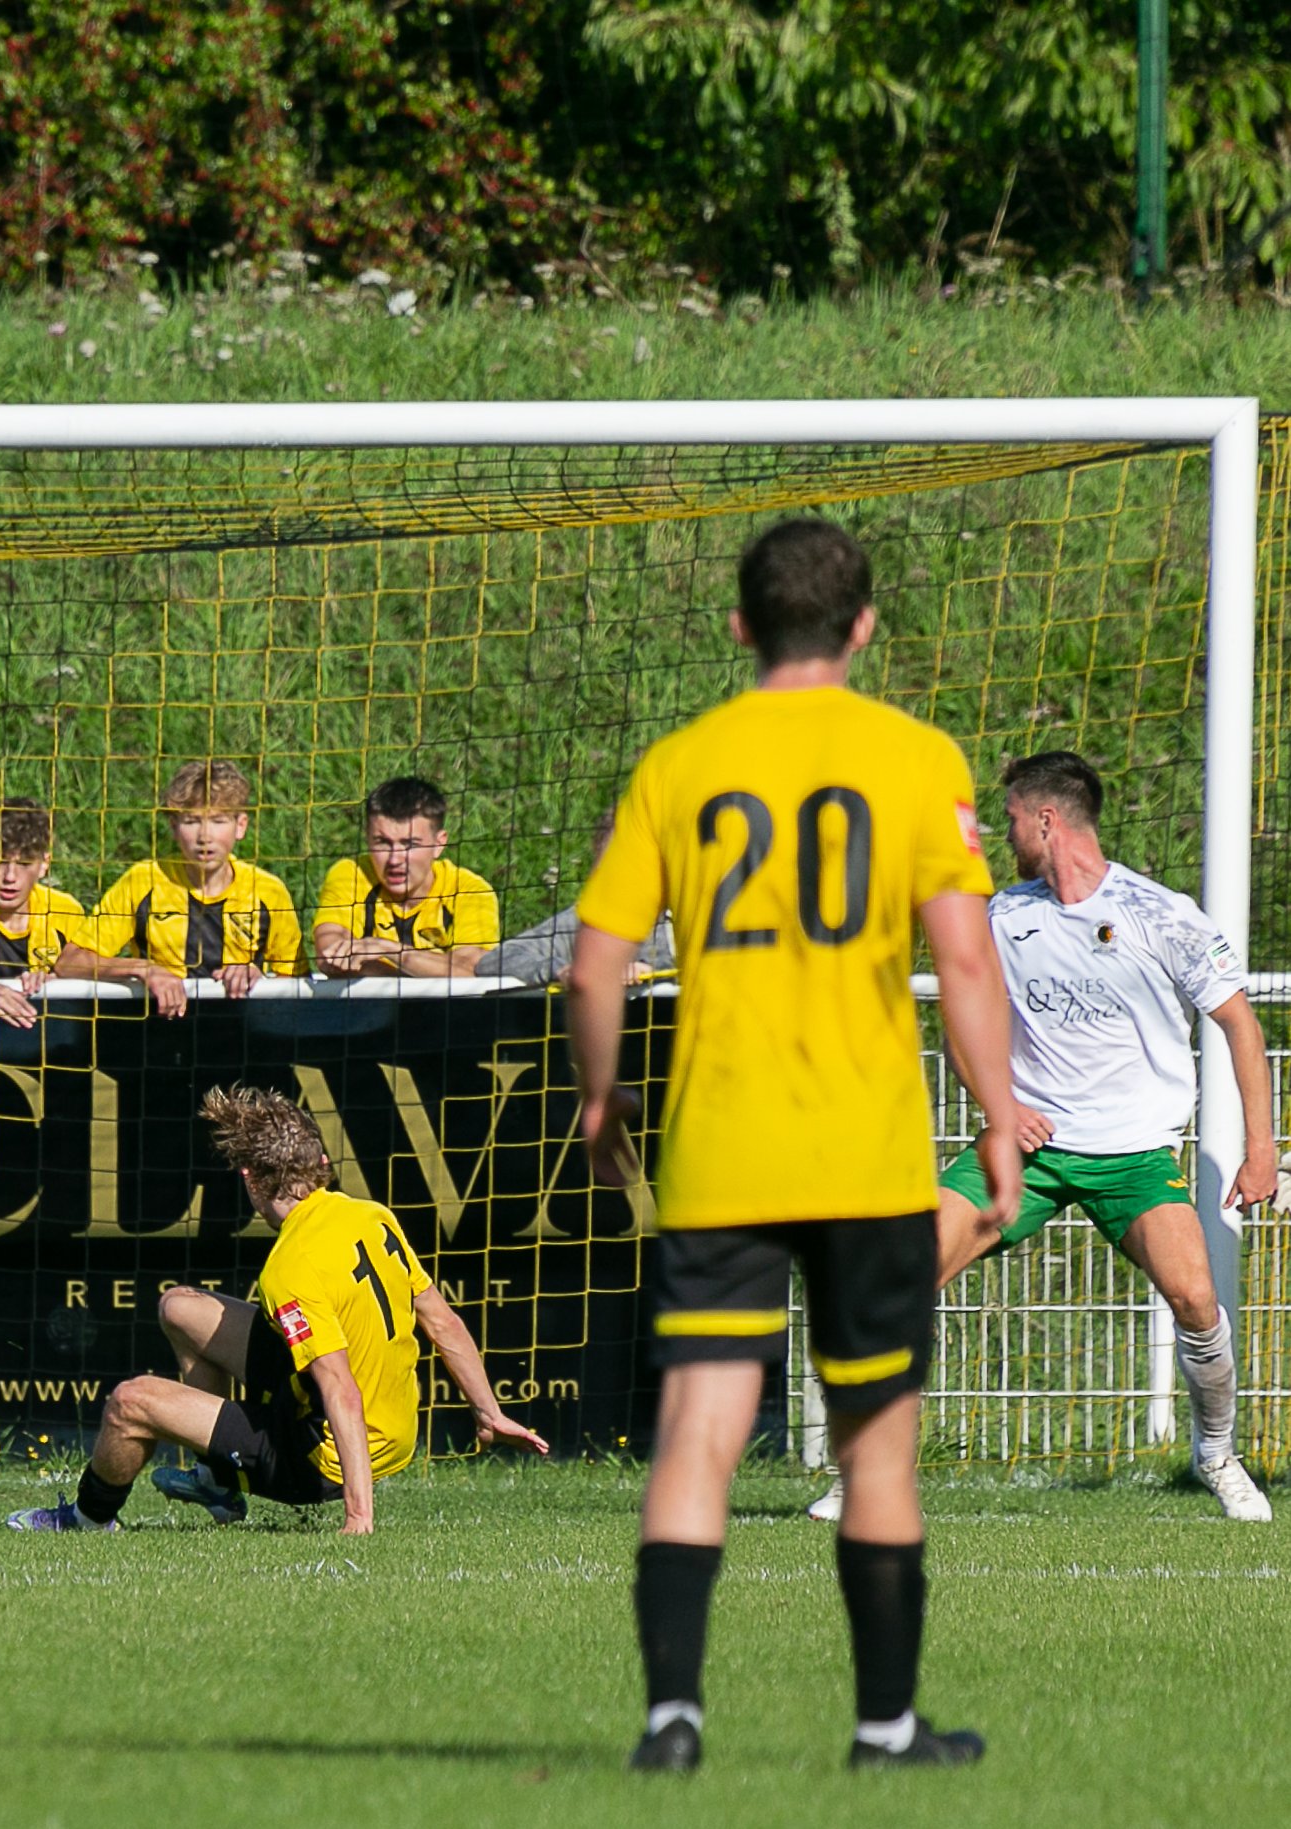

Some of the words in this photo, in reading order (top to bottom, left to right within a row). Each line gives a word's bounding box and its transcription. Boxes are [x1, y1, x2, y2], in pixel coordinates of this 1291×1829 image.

[696, 785, 872, 951] 20
[1026, 978, 1058, 1013] &
[351, 1222, 414, 1342] 11
